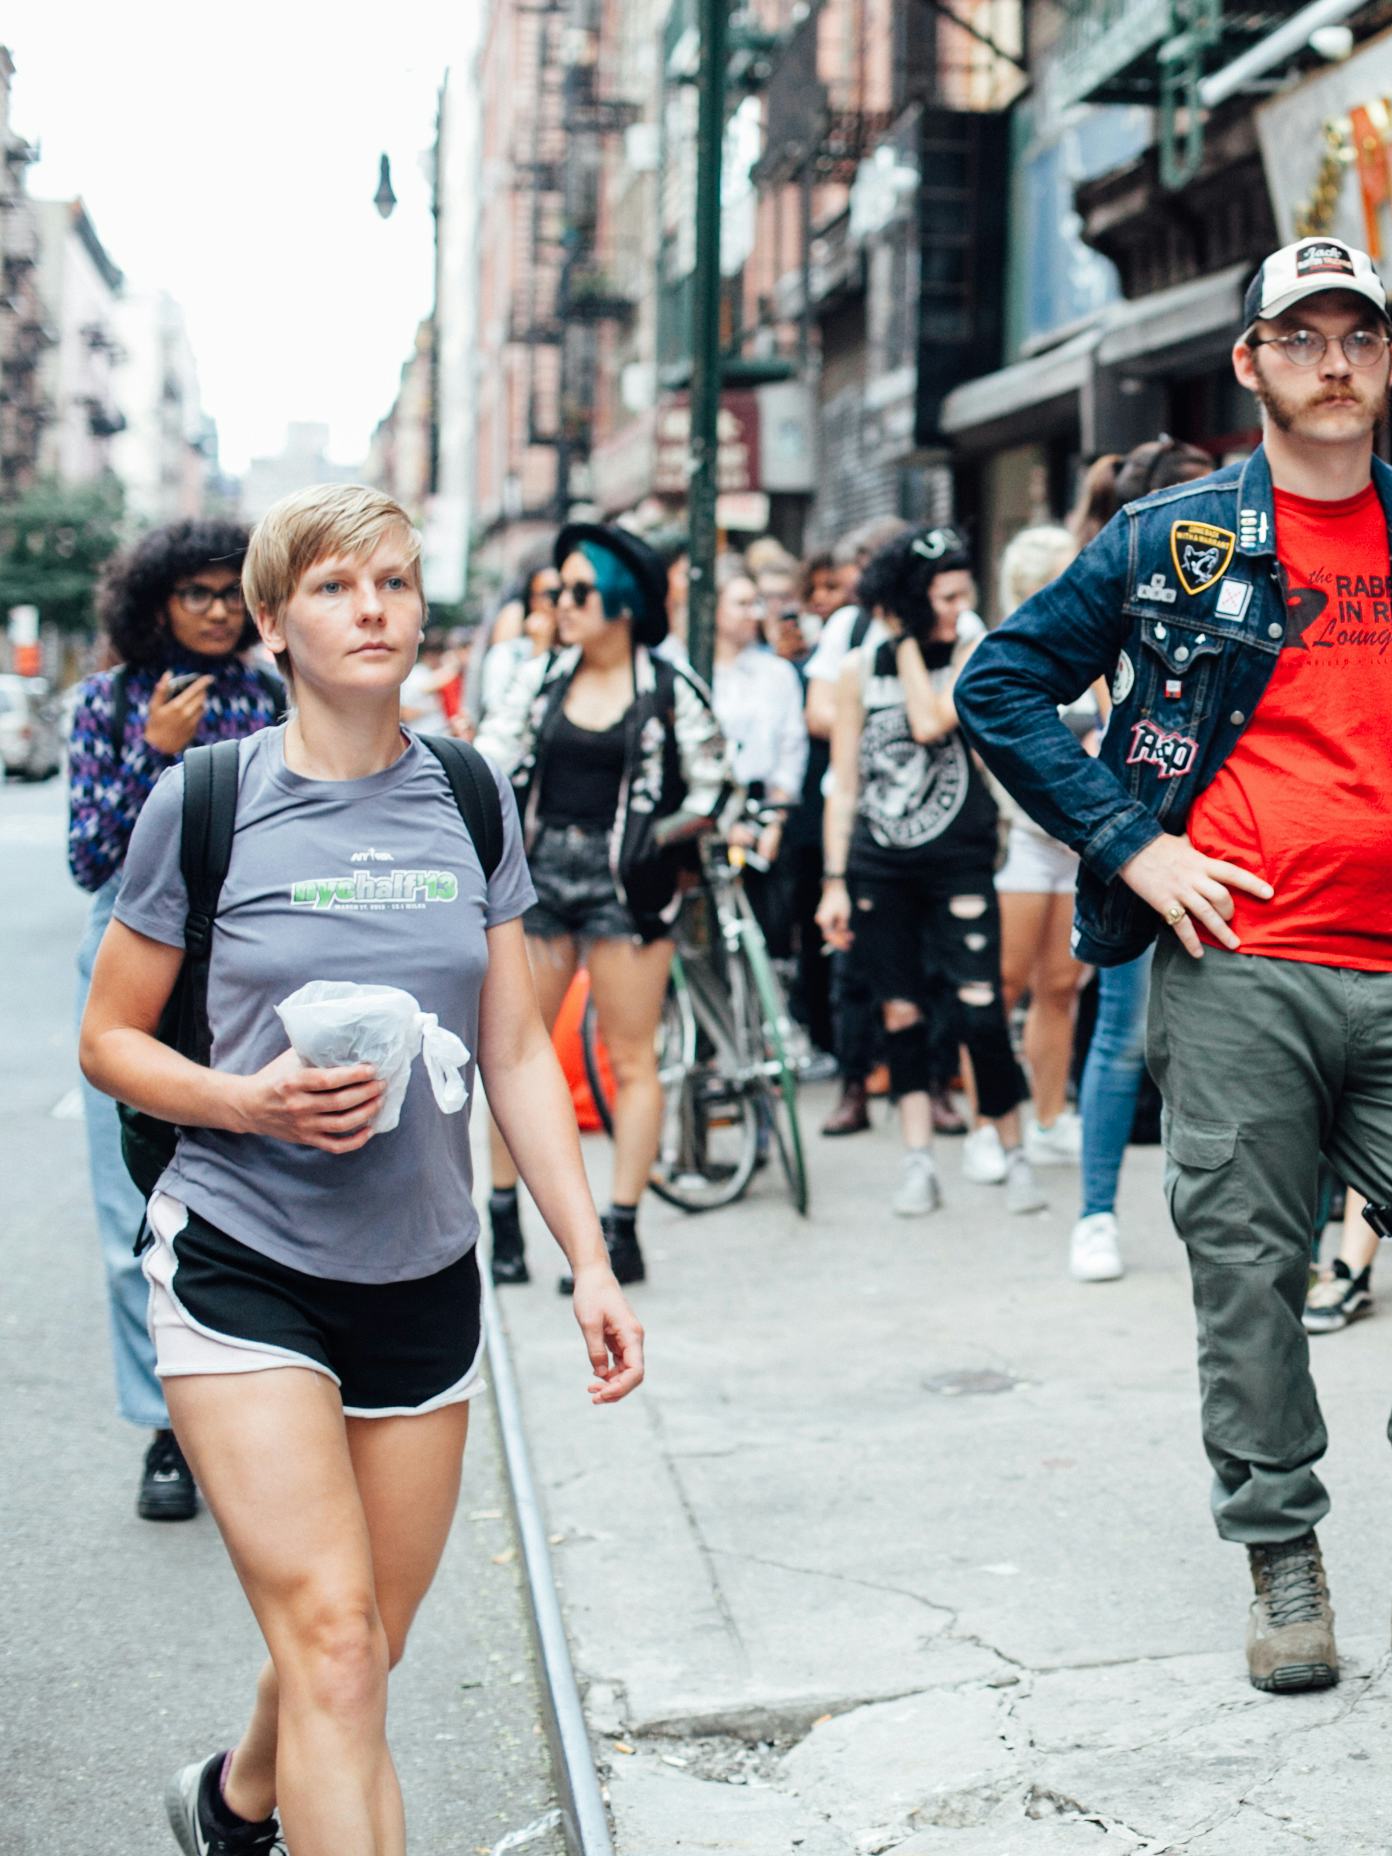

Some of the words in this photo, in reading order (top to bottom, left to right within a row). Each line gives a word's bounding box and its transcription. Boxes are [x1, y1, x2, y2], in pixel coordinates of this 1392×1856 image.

[1308, 566, 1333, 585] the
[1338, 601, 1363, 624] IN
[1374, 601, 1392, 623] R
